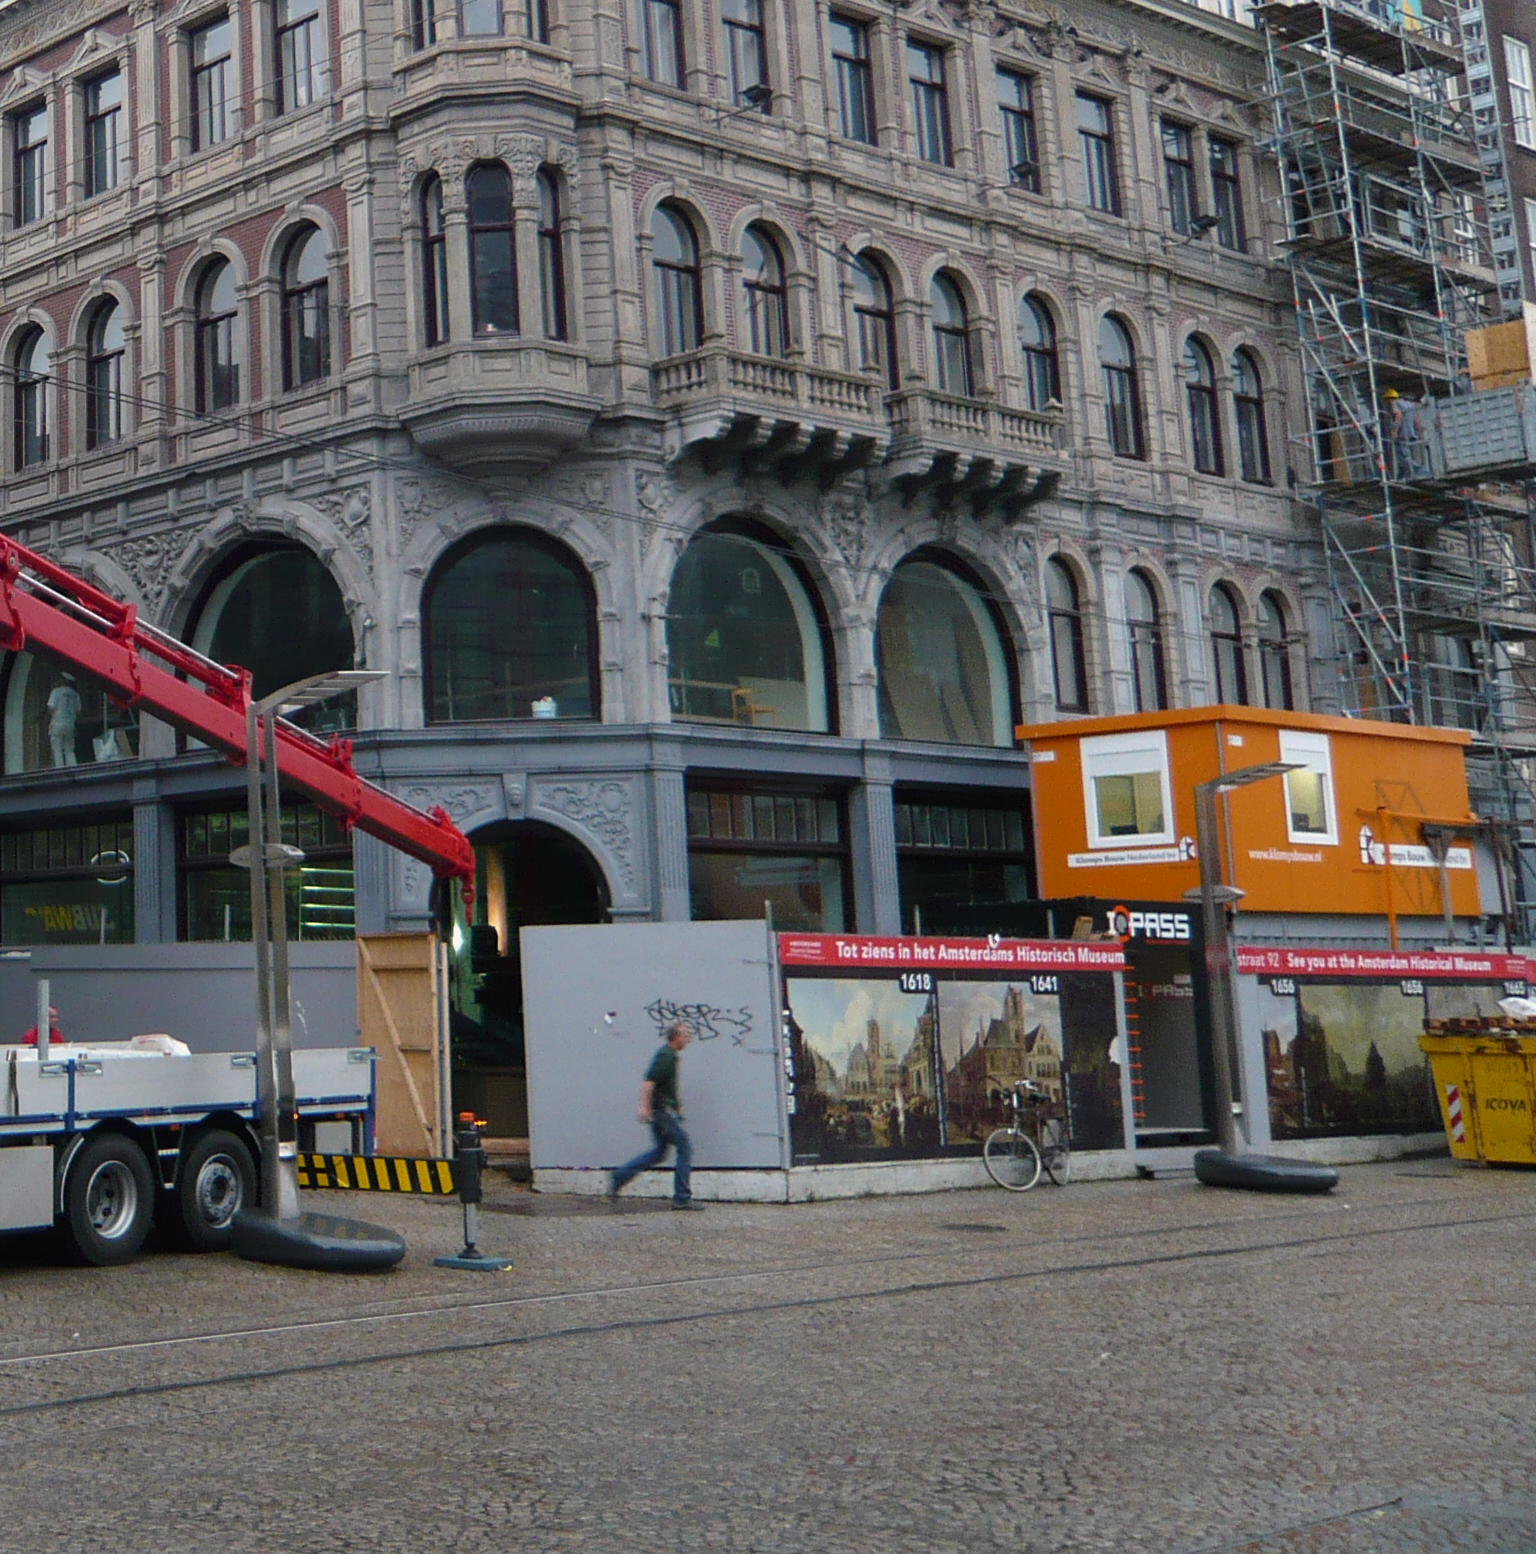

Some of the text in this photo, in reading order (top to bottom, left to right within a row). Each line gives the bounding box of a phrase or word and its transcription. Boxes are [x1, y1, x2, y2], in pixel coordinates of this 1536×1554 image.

[835, 940, 858, 959] Tot
[861, 942, 895, 960] ziens
[898, 942, 911, 960] in
[913, 943, 936, 961] het
[938, 944, 1014, 963] Amsterdams
[1016, 946, 1076, 964] Historisch
[1077, 947, 1125, 964] Museum
[1267, 952, 1280, 968] 92
[1287, 952, 1306, 968] See
[1307, 956, 1326, 972] you
[1327, 954, 1339, 969] at
[1339, 953, 1355, 969] the
[1357, 954, 1409, 970] Amsterdam
[1410, 955, 1454, 971] Historical
[1454, 956, 1492, 972] Museum
[901, 973, 931, 991] 1618
[1030, 975, 1058, 992] 1641
[1271, 979, 1295, 994] 1656
[1484, 1098, 1528, 1112] ICOVA
